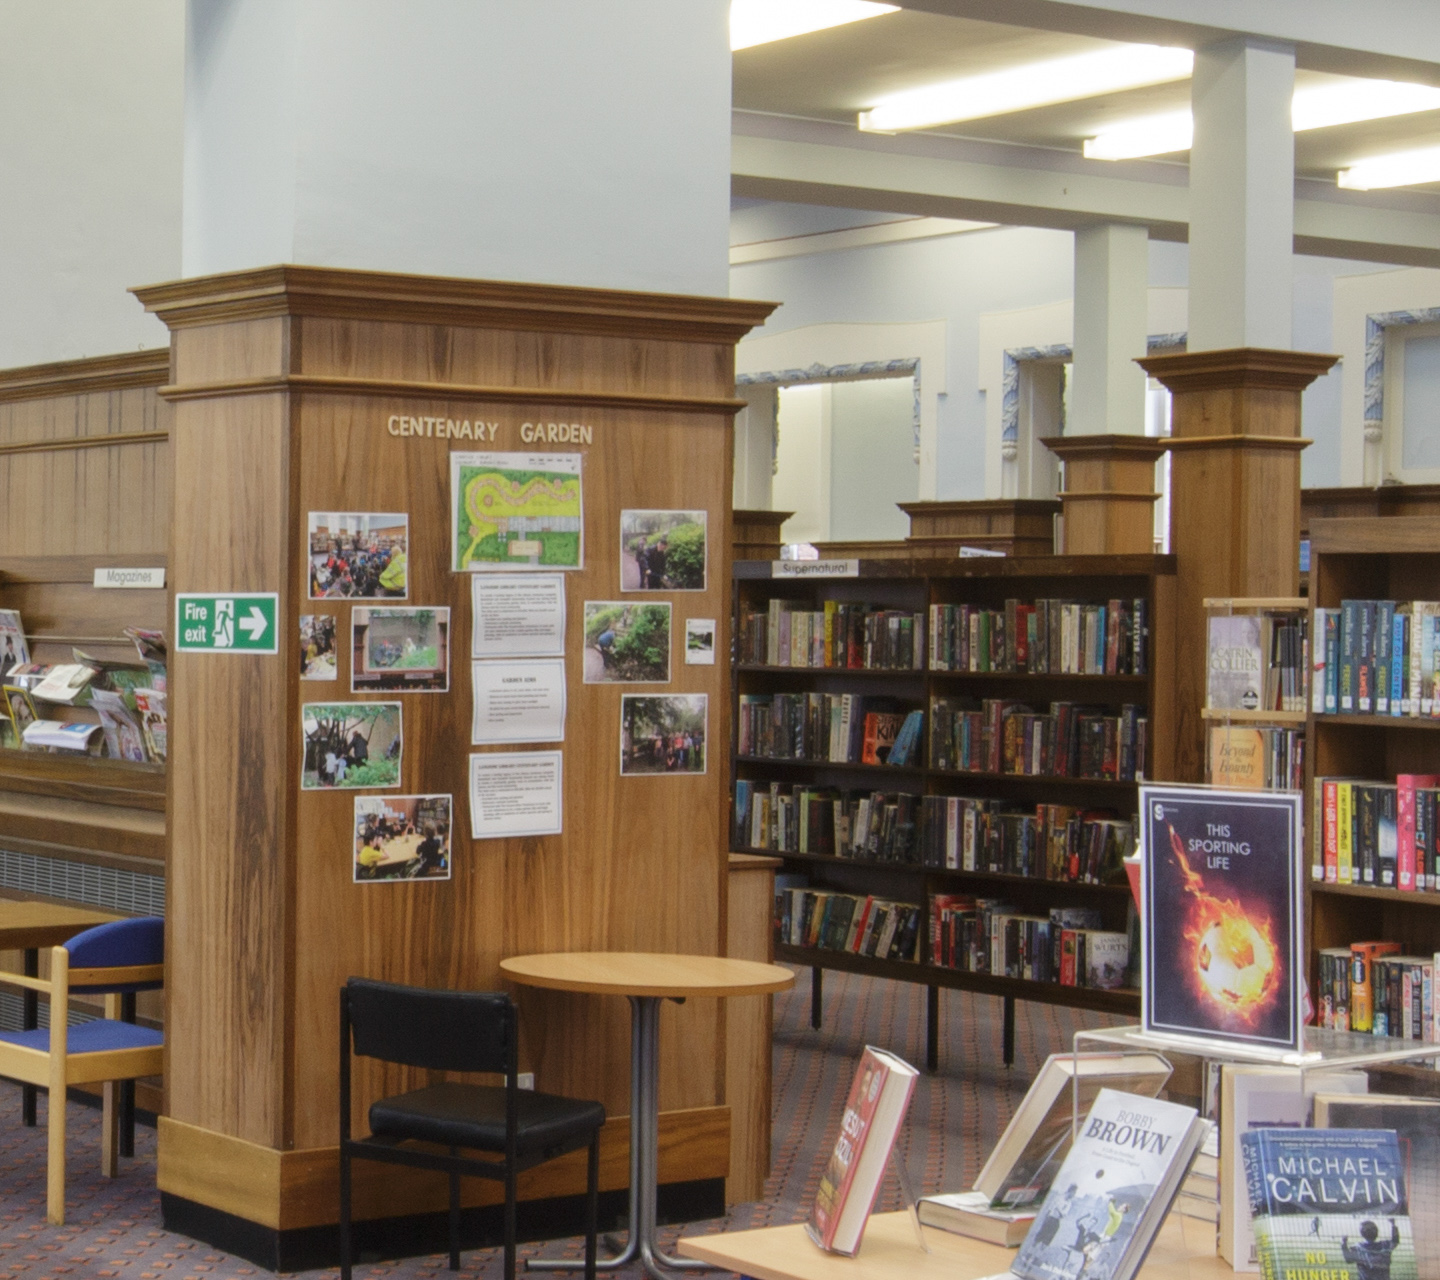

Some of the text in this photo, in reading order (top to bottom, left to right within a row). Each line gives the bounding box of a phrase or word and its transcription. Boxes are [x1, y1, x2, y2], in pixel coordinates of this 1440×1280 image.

[388, 415, 592, 444] CENTENARY GARDEN
[107, 569, 152, 584] Magazines
[783, 562, 848, 576] Supernatural
[184, 603, 207, 621] Fire
[184, 625, 207, 643] exit
[1218, 648, 1253, 660] CATRIN
[1210, 658, 1260, 672] COLLIER
[1206, 824, 1230, 838] THIS
[1189, 839, 1251, 856] SPORTING
[1207, 857, 1230, 869] LIFE
[1118, 1110, 1158, 1129] BOBBY
[1086, 1118, 1172, 1155] BROWN
[1278, 1156, 1386, 1176] MICHAEL
[1241, 1143, 1258, 1213] CALVIN
[1249, 1146, 1261, 1205] MICHAEL
[1272, 1178, 1399, 1204] CALVIN
[1306, 1252, 1327, 1264] NO
